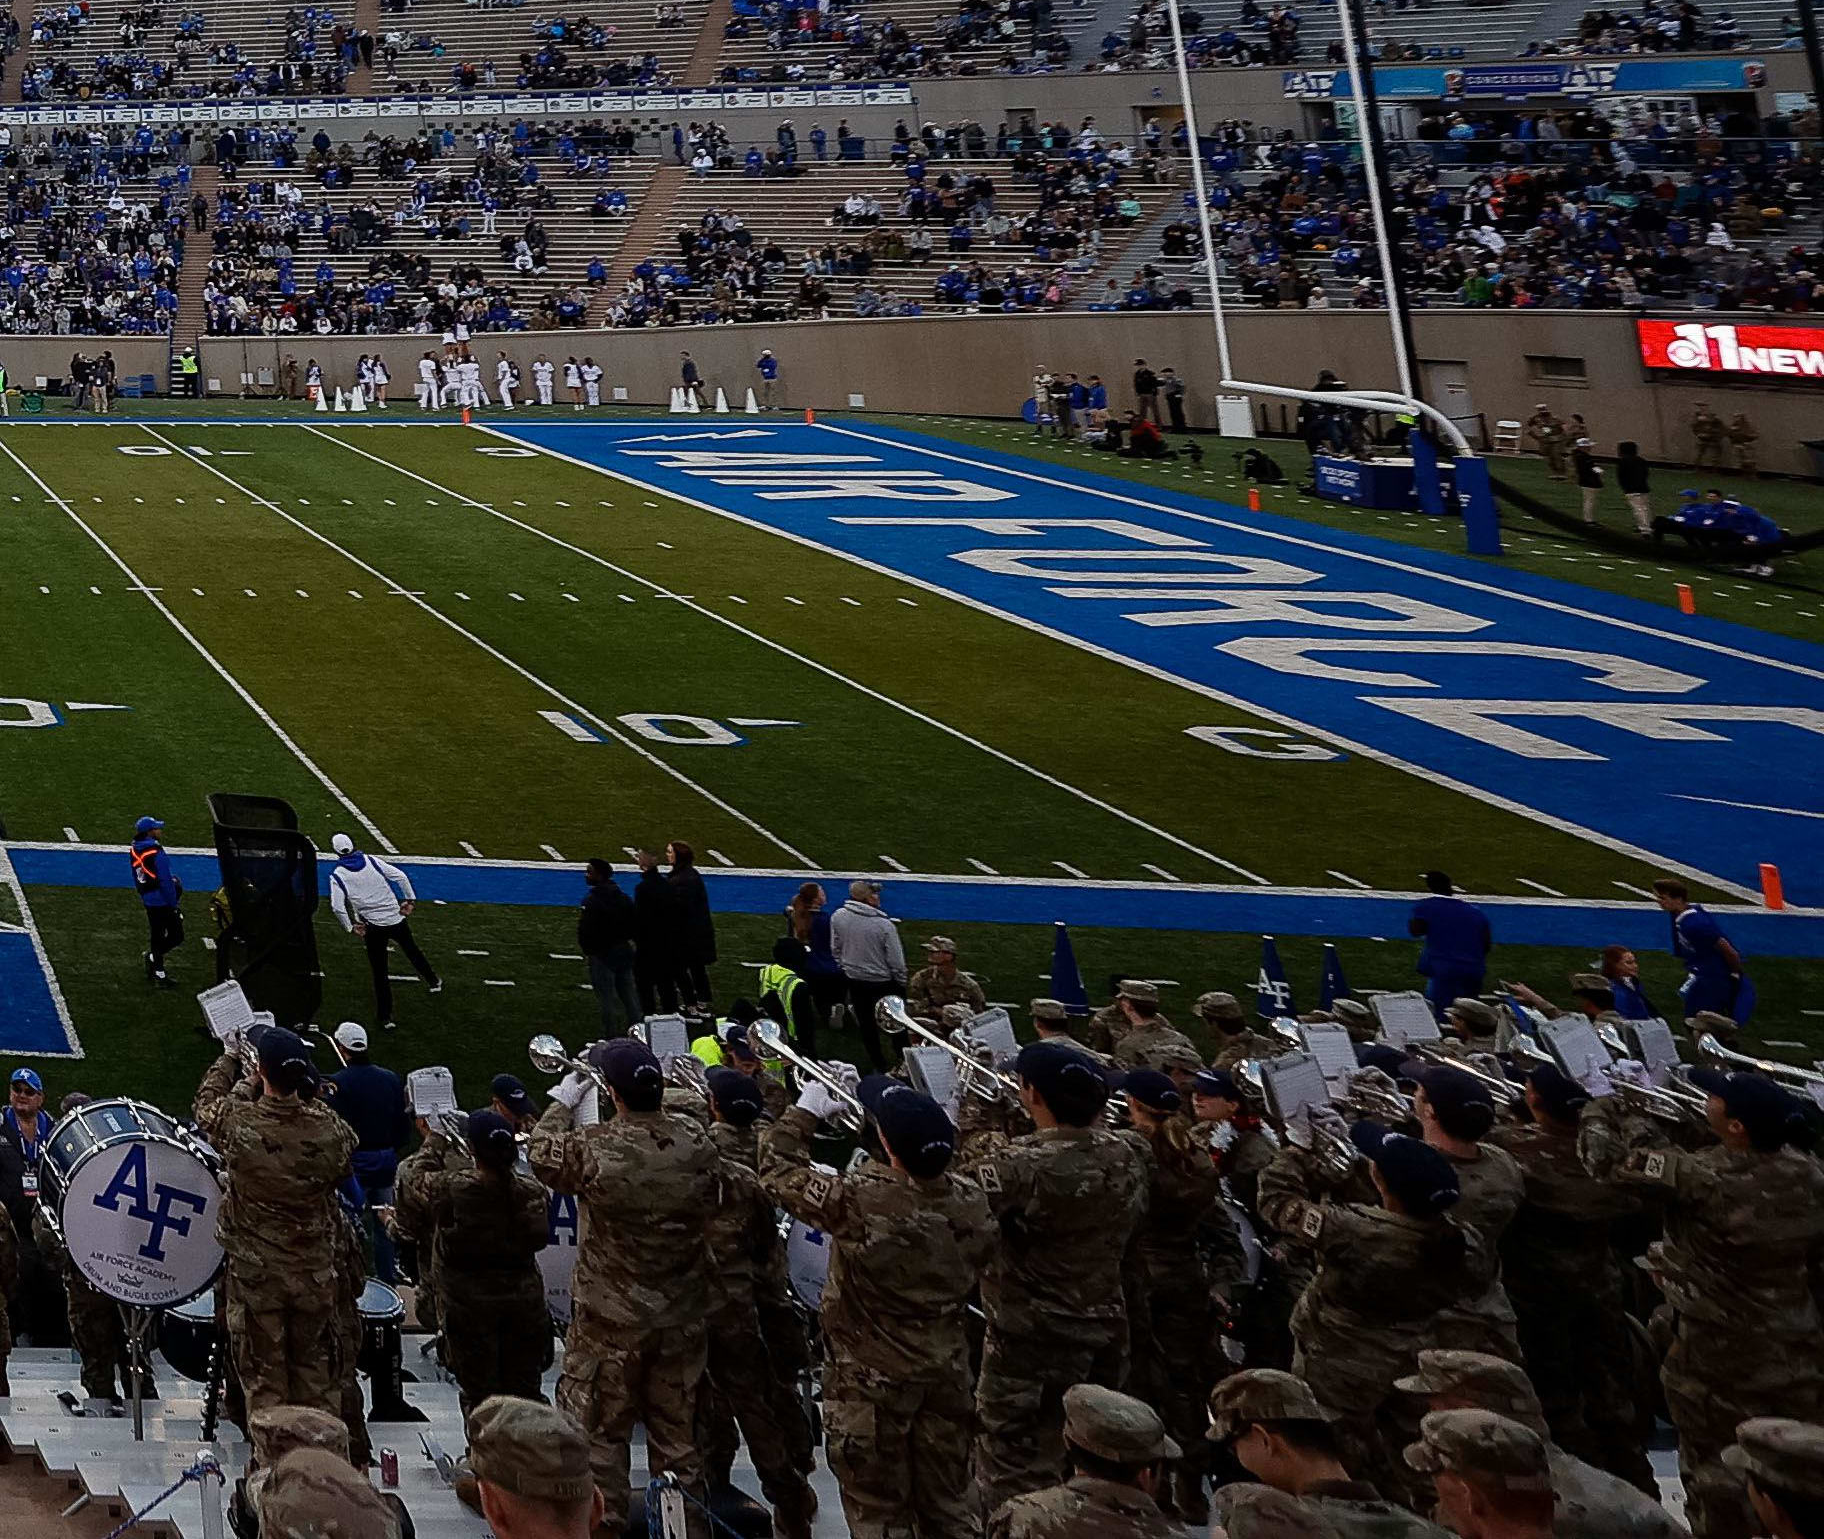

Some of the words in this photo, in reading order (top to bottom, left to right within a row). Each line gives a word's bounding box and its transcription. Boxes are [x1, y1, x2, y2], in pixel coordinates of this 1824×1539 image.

[656, 449, 1021, 502] AIR
[538, 709, 748, 748] 10
[92, 1143, 208, 1263] AF
[89, 1251, 104, 1262] AIR
[105, 1254, 134, 1272] FORCE
[135, 1264, 177, 1283] ACADEMY
[104, 1281, 123, 1295] AND
